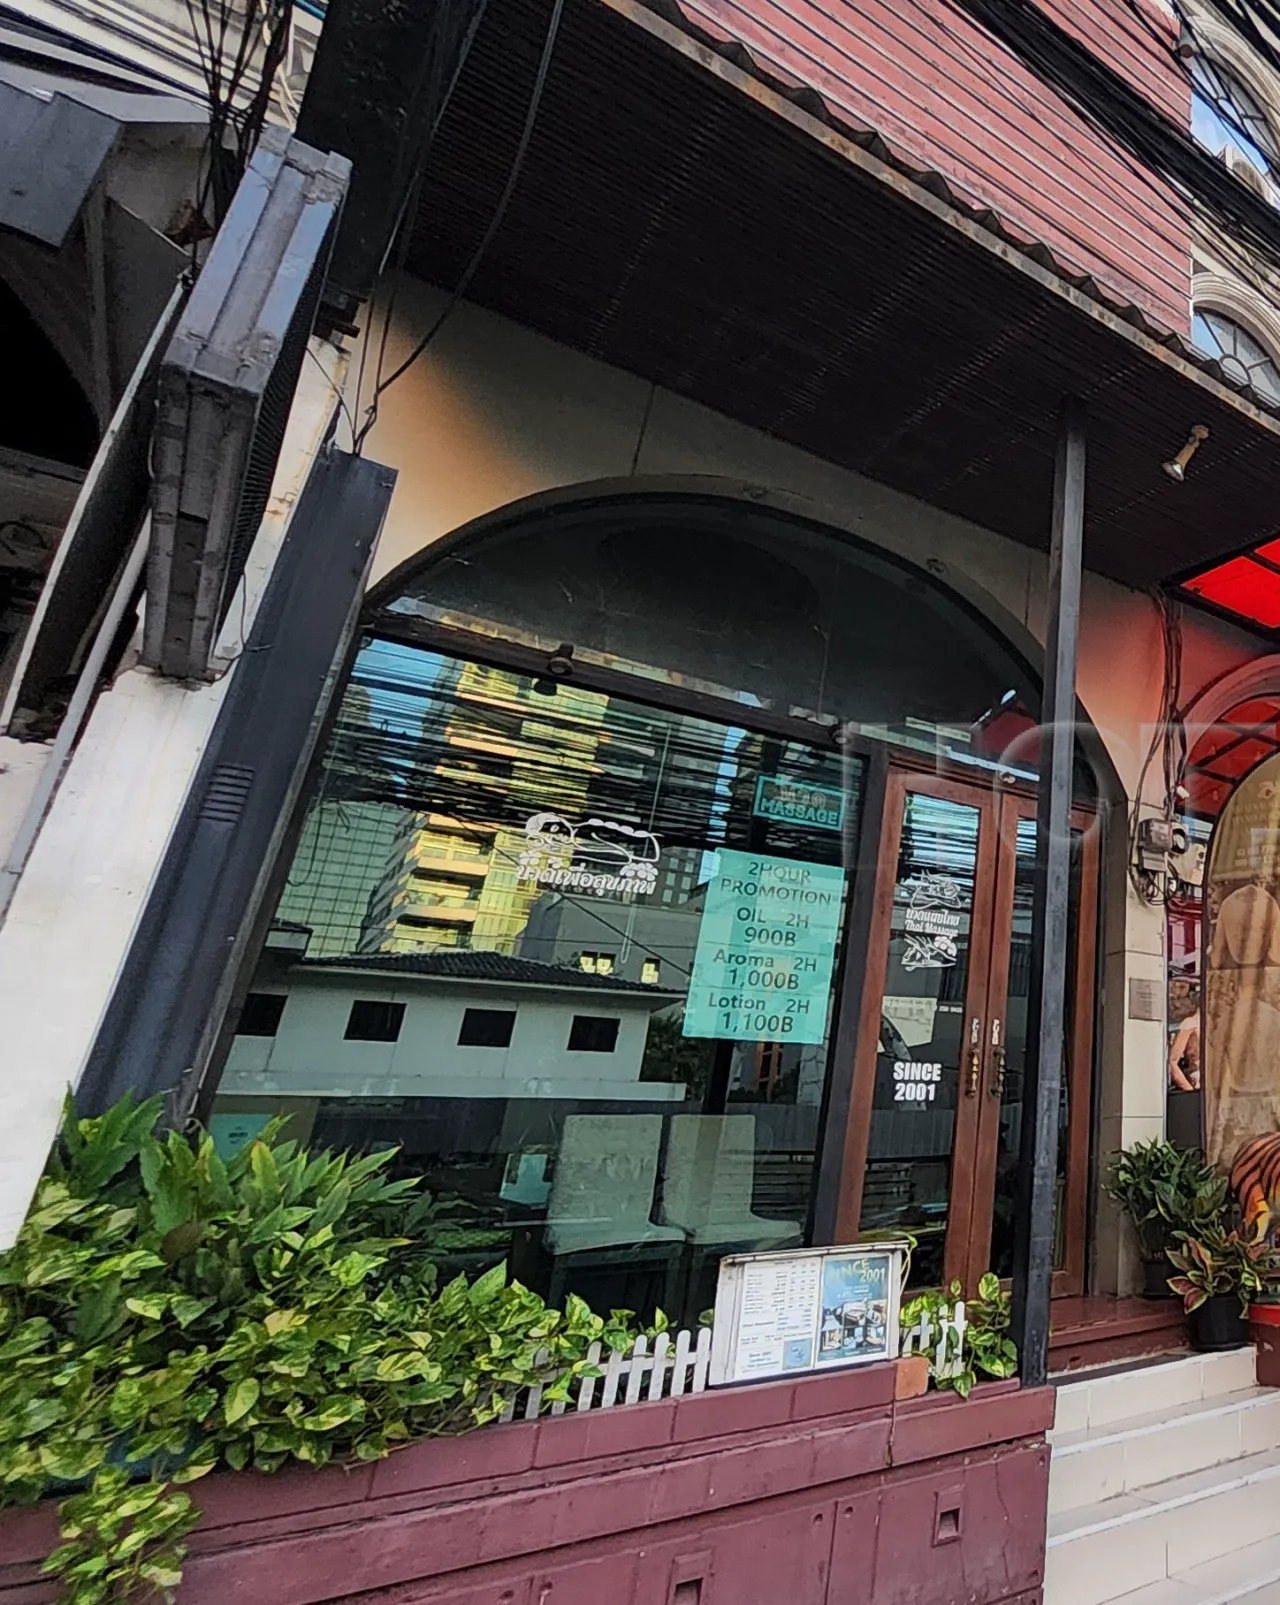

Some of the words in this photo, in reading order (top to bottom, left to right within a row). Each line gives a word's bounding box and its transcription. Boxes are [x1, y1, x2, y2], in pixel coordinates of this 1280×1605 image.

[760, 796, 838, 825] MASSAGE
[747, 860, 812, 885] 2HOUR
[720, 877, 832, 905] PROMOTION
[736, 906, 767, 923] OIL
[785, 912, 810, 929] 2H
[743, 926, 797, 947] 900B
[712, 948, 775, 968] Aroma
[793, 956, 817, 972] 2H
[728, 967, 800, 990] 1,000B
[708, 991, 766, 1011] Lotion
[785, 999, 810, 1014] 2H
[722, 1011, 794, 1033] 1,100B
[893, 1061, 942, 1081] SINCE
[894, 1082, 936, 1101] 2001
